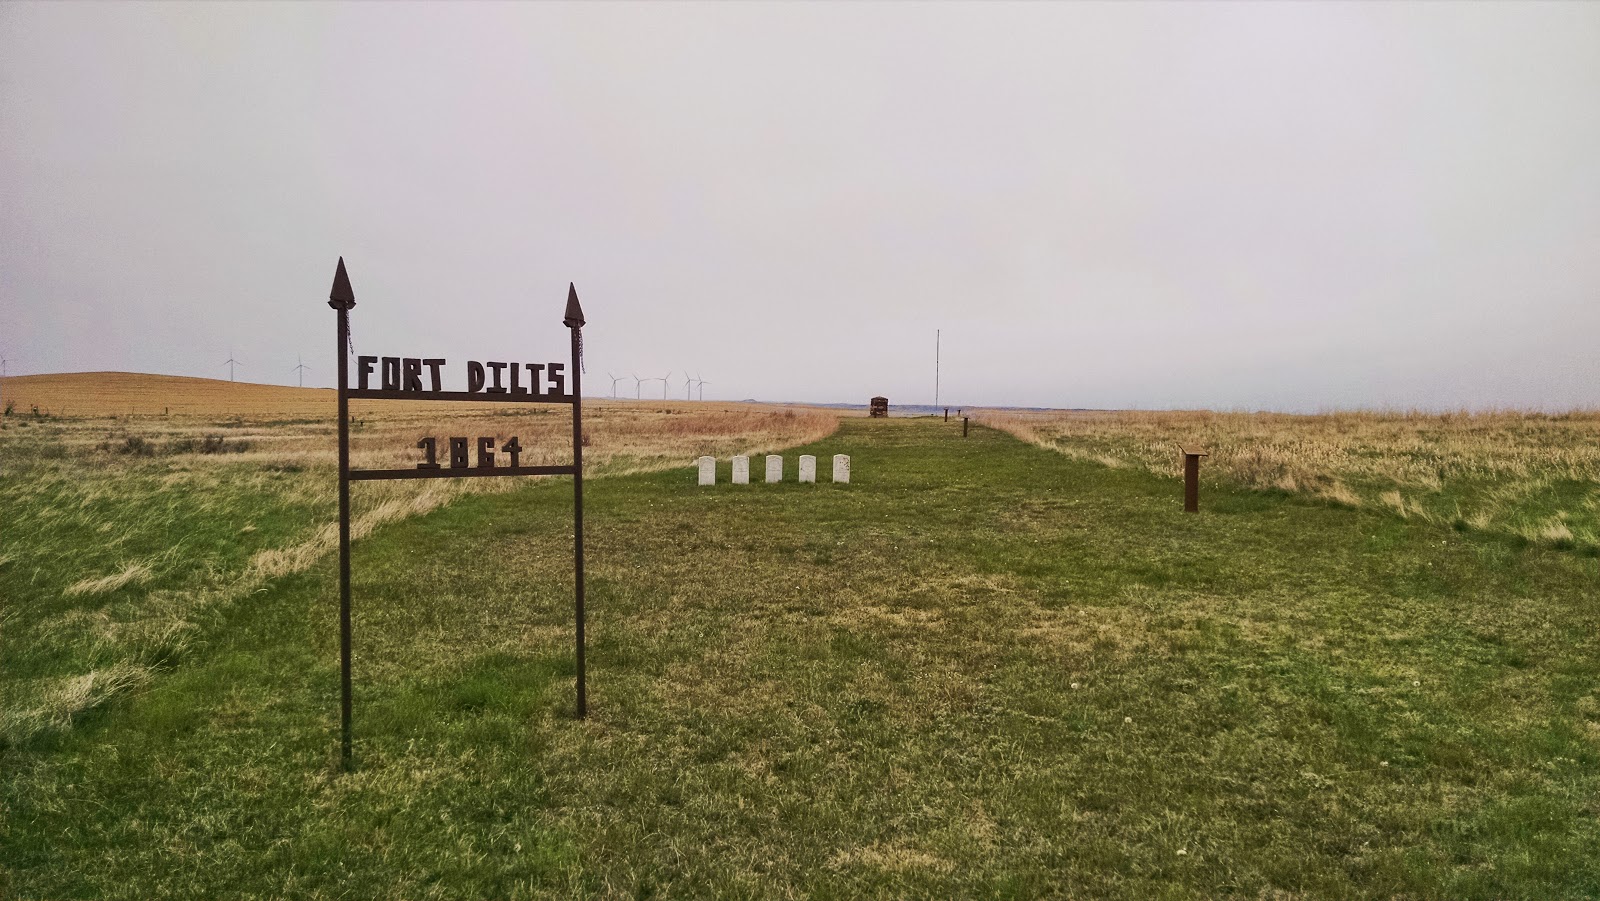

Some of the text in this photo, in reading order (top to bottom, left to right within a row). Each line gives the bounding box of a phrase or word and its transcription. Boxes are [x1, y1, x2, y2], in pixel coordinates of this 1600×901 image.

[358, 355, 565, 395] FORT DILTS
[417, 436, 522, 469] 1864
